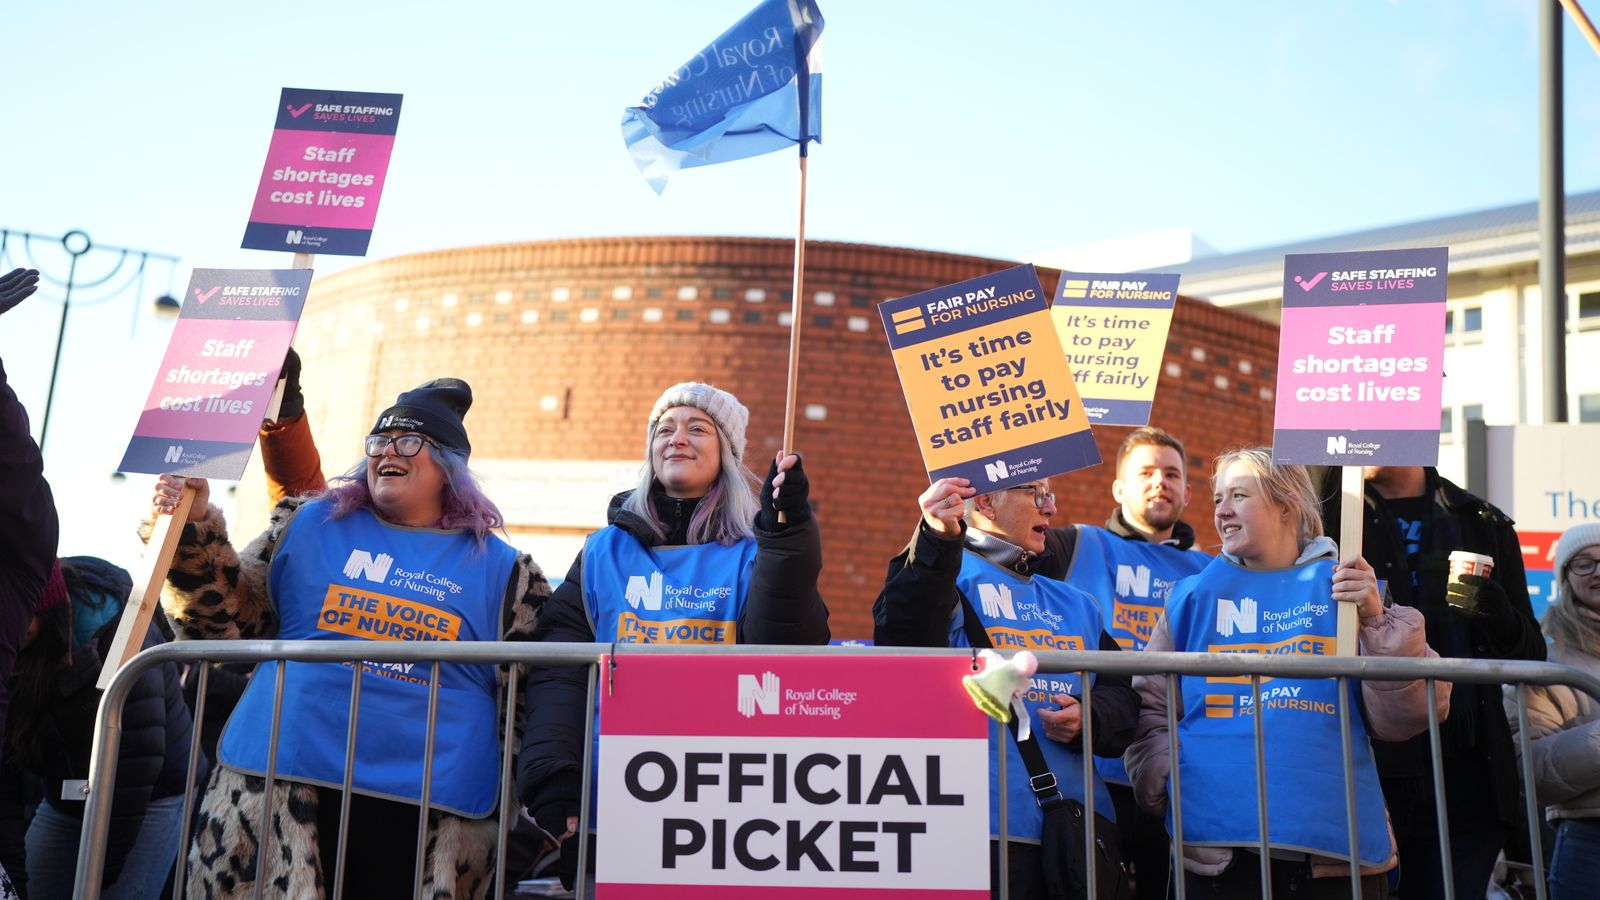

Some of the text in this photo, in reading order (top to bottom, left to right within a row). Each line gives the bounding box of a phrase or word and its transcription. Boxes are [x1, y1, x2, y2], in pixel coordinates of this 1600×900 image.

[313, 112, 376, 123] SAVES LIVES
[315, 104, 393, 116] SAFE STAFFING
[303, 146, 356, 163] Staff
[272, 166, 375, 188] shortages
[270, 190, 365, 208] cost lives
[1331, 267, 1437, 281] SAFE STAFFING
[222, 286, 300, 296] SAFE STAFFING
[1091, 280, 1147, 291] FAIR PAY
[1330, 279, 1415, 292] SAVES LIVES
[219, 297, 282, 306] SAVES LIVES
[926, 286, 996, 314] FAIR PAY
[1089, 290, 1171, 300] FOR NURSING
[930, 289, 1036, 326] FOR NURSING
[1103, 315, 1150, 330] time
[1072, 334, 1136, 351] to pay
[1327, 324, 1396, 345] Staff
[201, 339, 256, 358] Staff
[968, 330, 1032, 358] time
[1292, 353, 1428, 377] shortages
[166, 365, 267, 390] shortages
[941, 357, 1026, 392] to pay
[1095, 370, 1149, 389] fairly
[939, 379, 1046, 419] nursing
[1295, 380, 1421, 402] cost lives
[159, 394, 254, 415] cost lives
[930, 399, 1070, 449] staff fairly
[1008, 457, 1043, 470] Royal College
[1017, 466, 1038, 475] Nursing
[394, 567, 463, 593] Royal College
[1153, 577, 1176, 590] Roy
[389, 578, 446, 601] of Nursing
[664, 584, 732, 599] Royal College
[1152, 589, 1163, 599] of
[338, 592, 450, 633] THE VOICE
[665, 597, 716, 612] of Nursing
[1263, 602, 1329, 623] Royal College
[323, 609, 353, 626] OF
[1021, 612, 1031, 622] of
[1262, 616, 1313, 633] of Nursing
[664, 625, 725, 642] VOICE
[991, 632, 1079, 650] THE VOCE
[1030, 678, 1073, 694] AIR PAY
[785, 688, 857, 705] Royal College
[1240, 686, 1302, 706] FAR PAY
[784, 703, 841, 720] of Nursing
[1267, 699, 1336, 714] NURSING
[624, 750, 965, 806] OFFICIAL
[661, 817, 927, 873] PICKET
